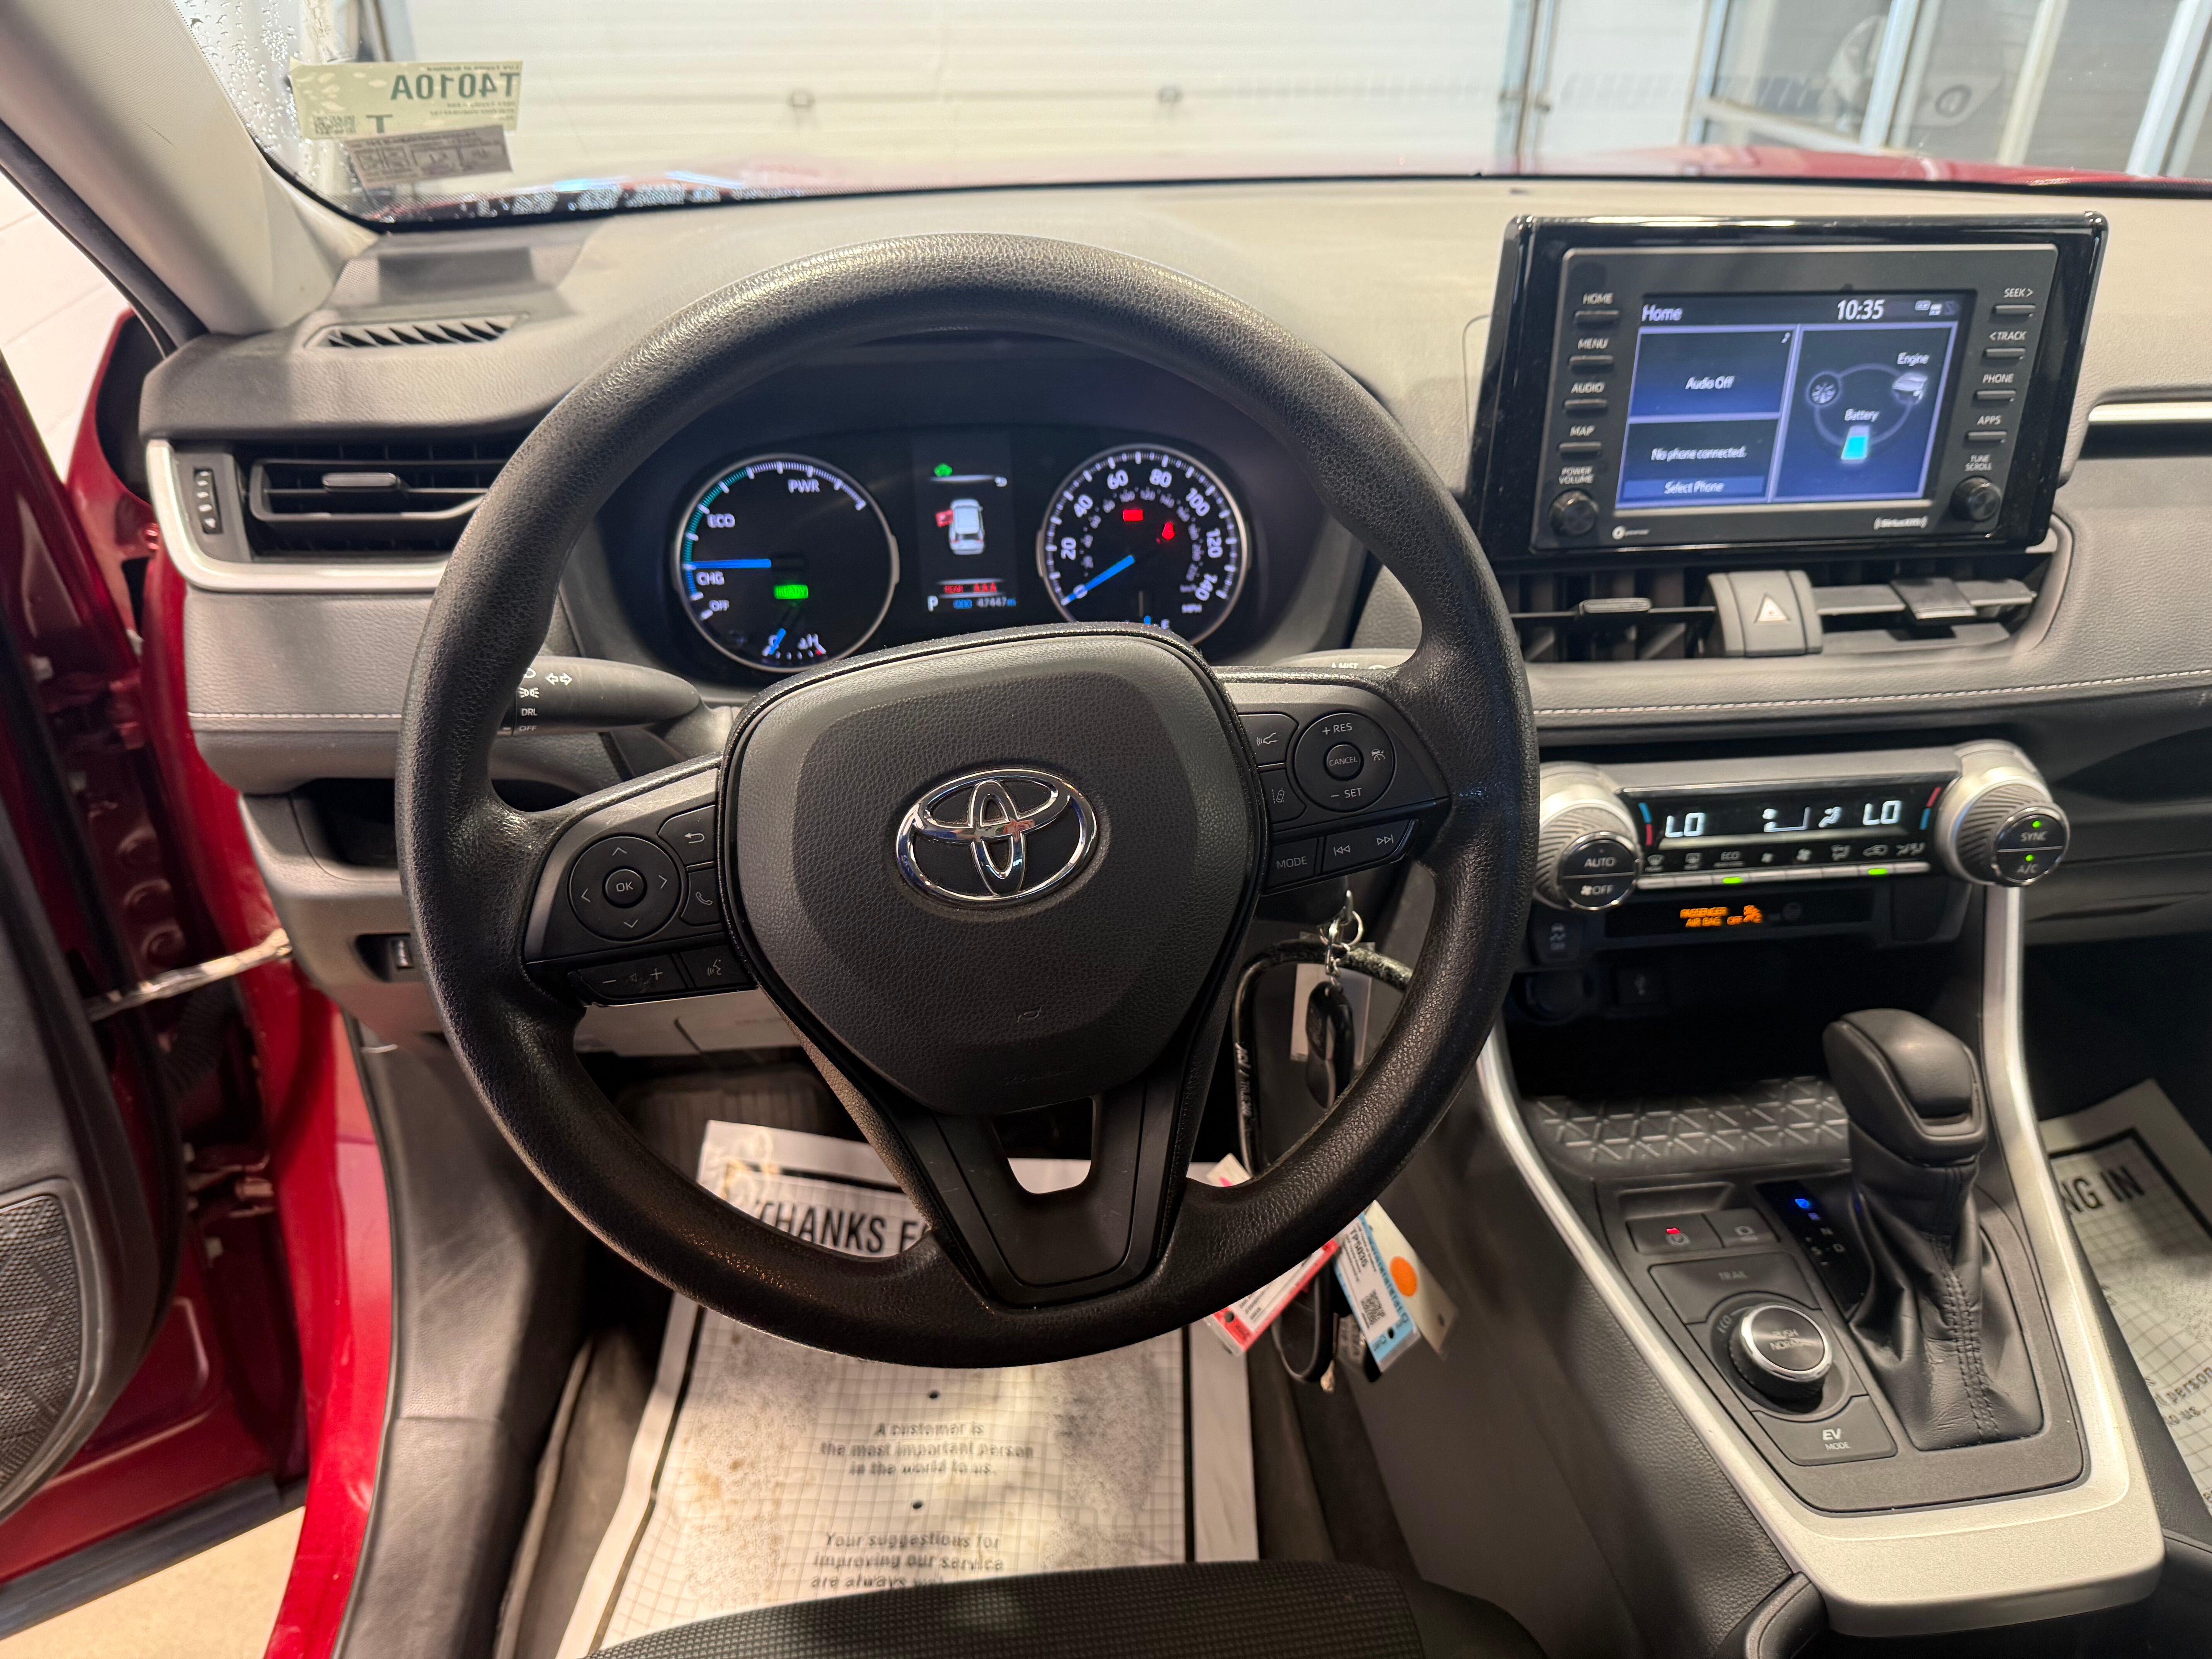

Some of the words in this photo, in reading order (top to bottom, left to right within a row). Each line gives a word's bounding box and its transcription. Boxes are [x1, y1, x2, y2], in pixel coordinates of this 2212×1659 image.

[1583, 293, 1614, 304] HOME
[1642, 304, 1683, 321] Home
[1837, 299, 1885, 319] 10:35
[1578, 338, 1608, 349] MENU
[1898, 352, 1930, 366] Engine
[1715, 375, 1735, 389] Off
[1983, 374, 2014, 383] PHONE
[1571, 382, 1605, 393] AUDIO
[1844, 409, 1880, 422] Battery
[1977, 416, 2001, 425] APPS
[1570, 426, 1595, 436] MAP
[1651, 448, 1667, 460] No
[1667, 449, 1696, 462] phone
[1561, 466, 1593, 476] POWER
[1107, 470, 1128, 489] 60
[1149, 468, 1172, 488] 80
[1559, 475, 1594, 484] VOLUME
[788, 479, 820, 493] PWR
[1664, 481, 1693, 494] Select
[1693, 481, 1724, 492] Phone
[1074, 495, 1093, 517] 40
[1186, 488, 1210, 517] 100
[707, 514, 735, 527] ECO
[1061, 538, 1077, 560] 20
[1206, 527, 1223, 558] 120
[697, 572, 725, 585] CHG
[928, 596, 938, 611] P
[1333, 723, 1352, 733] RES
[1329, 756, 1358, 766] CANCEL
[1344, 788, 1362, 798] SET
[1863, 800, 1901, 825] LO
[1665, 812, 1705, 837] LO
[2020, 831, 2048, 842] SYNC
[1276, 856, 1307, 869] MODE
[1584, 857, 1616, 867] AUTO
[2017, 864, 2038, 874] A/C
[616, 881, 633, 892] OK
[1592, 884, 1614, 895] OFF
[2102, 1165, 2144, 1203] IN
[876, 1423, 886, 1436] A
[891, 1422, 964, 1436] customer
[971, 1421, 984, 1435] is
[1822, 1429, 1841, 1440] EV
[821, 1441, 846, 1456] the
[852, 1443, 890, 1457] most
[896, 1441, 974, 1458] important
[978, 1443, 1034, 1459] person
[1825, 1441, 1850, 1450] MODE
[849, 1462, 865, 1475] in
[871, 1462, 896, 1475] the
[902, 1459, 946, 1475] world
[951, 1459, 969, 1475] to
[826, 1532, 863, 1547] Your
[869, 1532, 970, 1550] suggestions
[978, 1532, 1000, 1549] for
[814, 1552, 900, 1569] improving
[907, 1553, 934, 1569] our
[941, 1555, 1004, 1571] service
[811, 1575, 838, 1589] are
[844, 1574, 906, 1589] always
